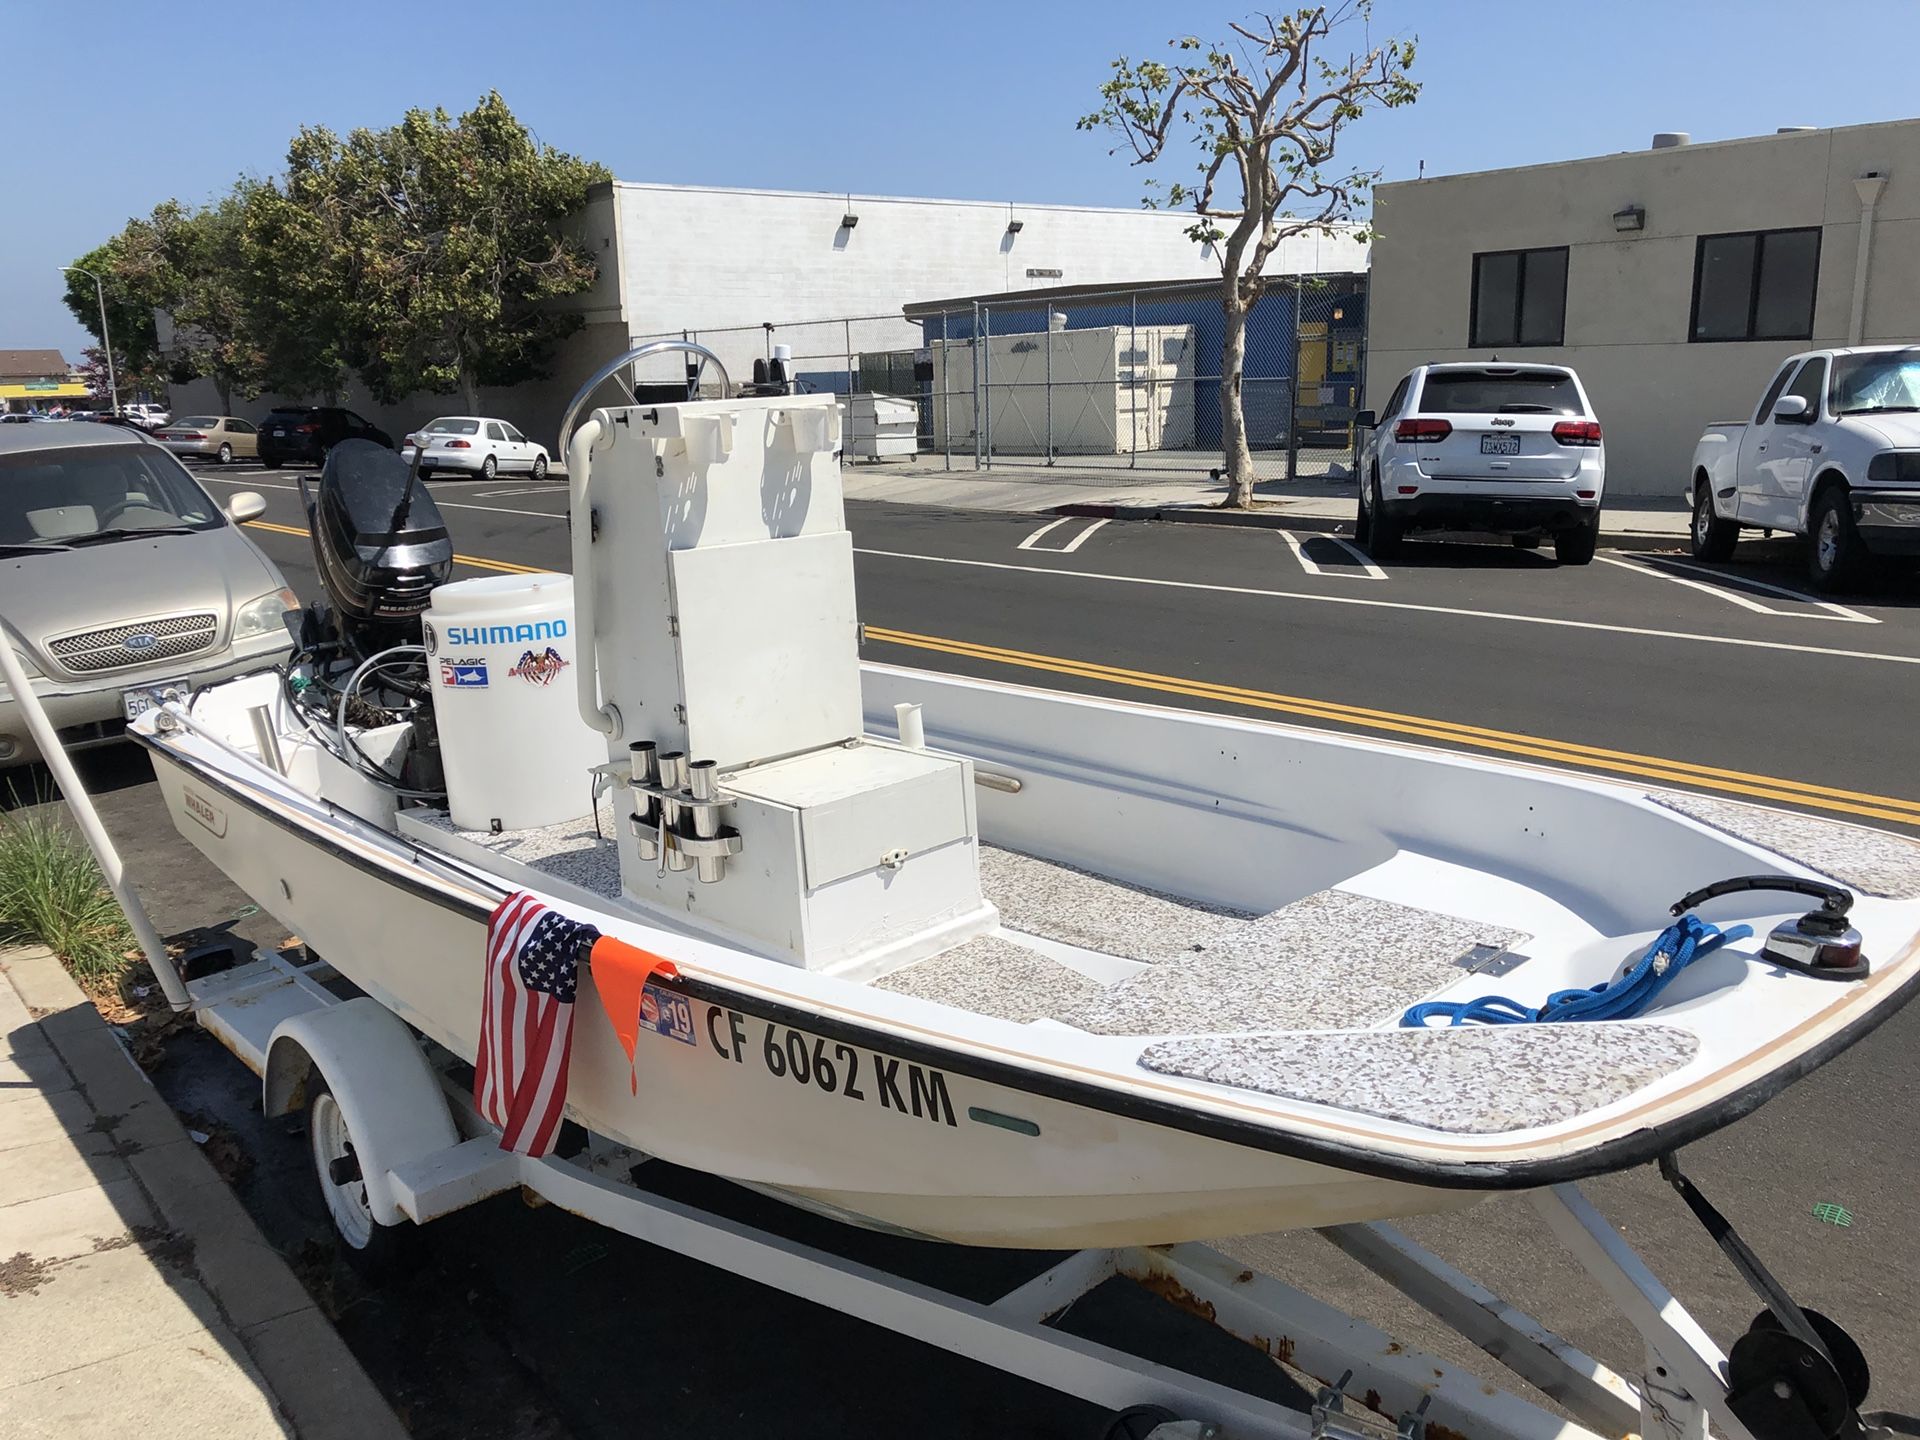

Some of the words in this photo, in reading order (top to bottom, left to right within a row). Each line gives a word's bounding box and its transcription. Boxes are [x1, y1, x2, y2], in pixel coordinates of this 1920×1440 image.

[1490, 417, 1515, 428] Jeep
[447, 619, 567, 645] SHIMANO
[128, 636, 153, 648] KIA
[439, 657, 487, 666] PELAGIC
[667, 1000, 691, 1034] 19
[706, 1005, 748, 1064] CF
[763, 1023, 865, 1101] 6062
[873, 1054, 958, 1128] KM
